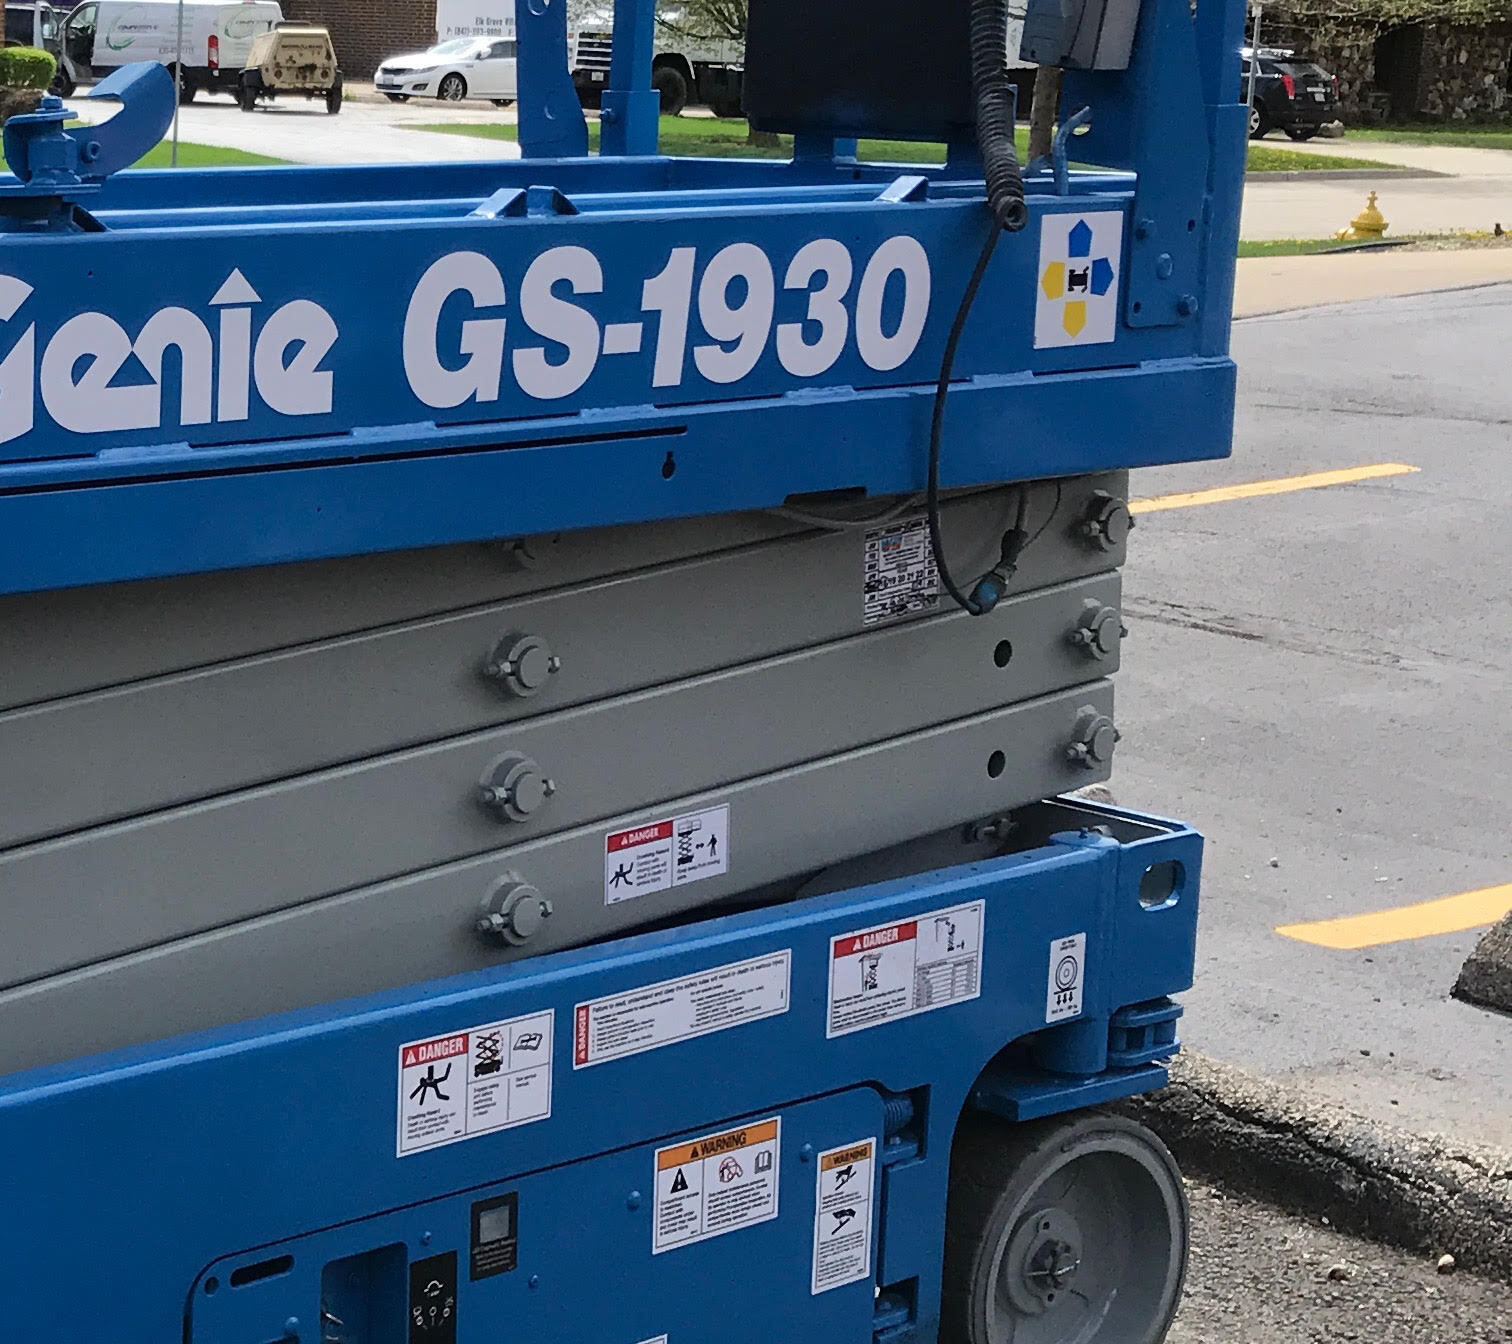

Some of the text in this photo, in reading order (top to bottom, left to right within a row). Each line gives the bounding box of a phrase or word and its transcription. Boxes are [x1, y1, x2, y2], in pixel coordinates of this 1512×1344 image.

[403, 236, 931, 406] GS-1930
[628, 827, 659, 844] DANGER
[863, 927, 898, 948] DANGER
[419, 1038, 463, 1061] DANGER
[700, 1133, 746, 1156] WARNING
